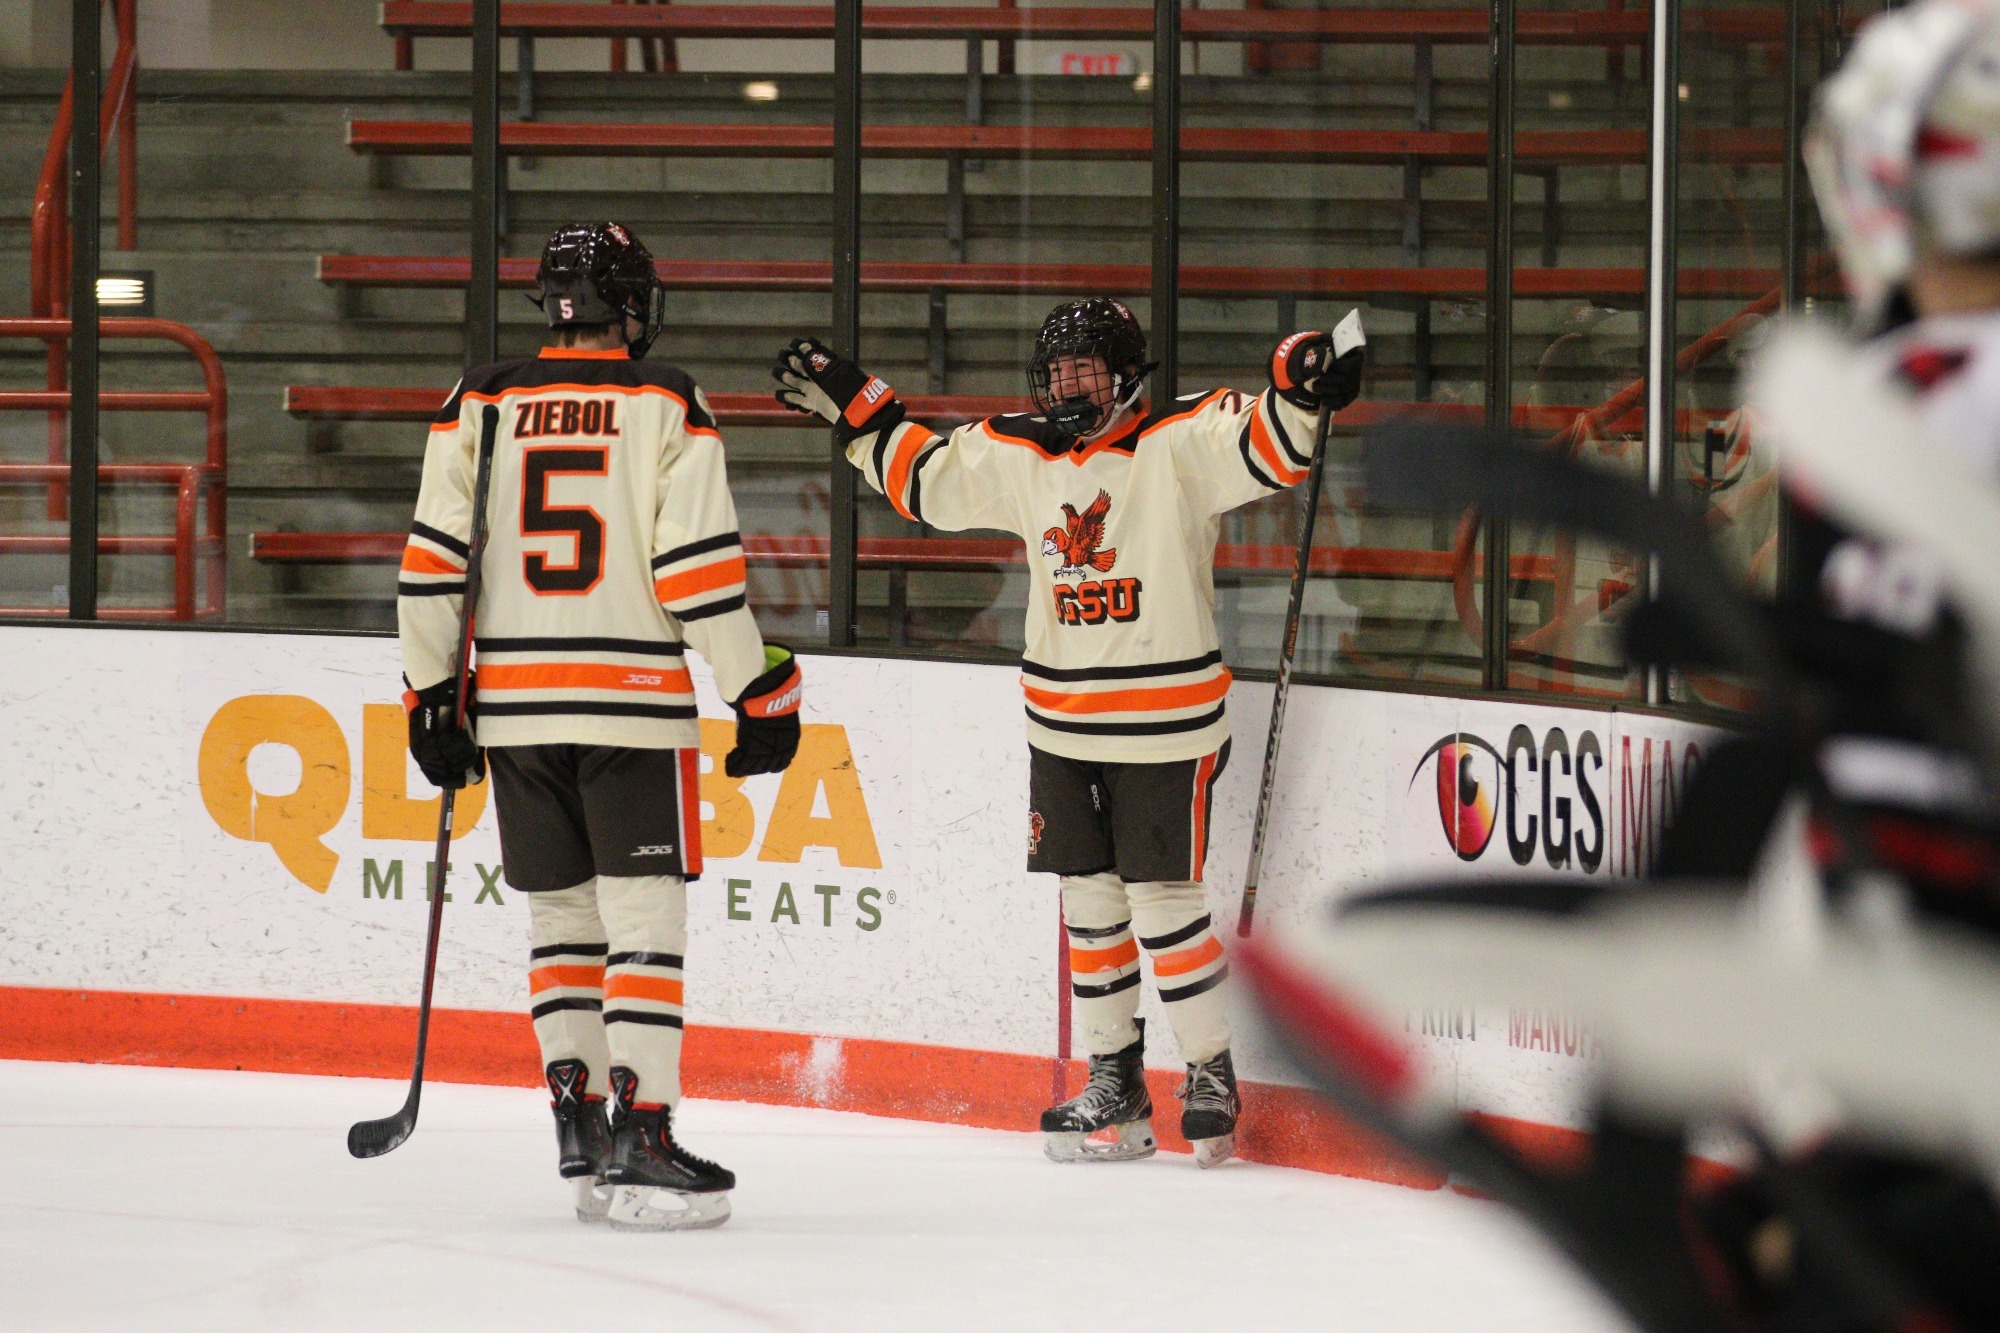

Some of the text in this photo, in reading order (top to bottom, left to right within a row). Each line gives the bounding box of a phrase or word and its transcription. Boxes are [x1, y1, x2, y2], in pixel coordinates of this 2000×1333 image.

[559, 298, 574, 320] 5
[514, 399, 620, 440] ZIEBOL
[520, 446, 610, 597] 5
[1052, 577, 1142, 626] GSU
[1506, 723, 1604, 875] CGS
